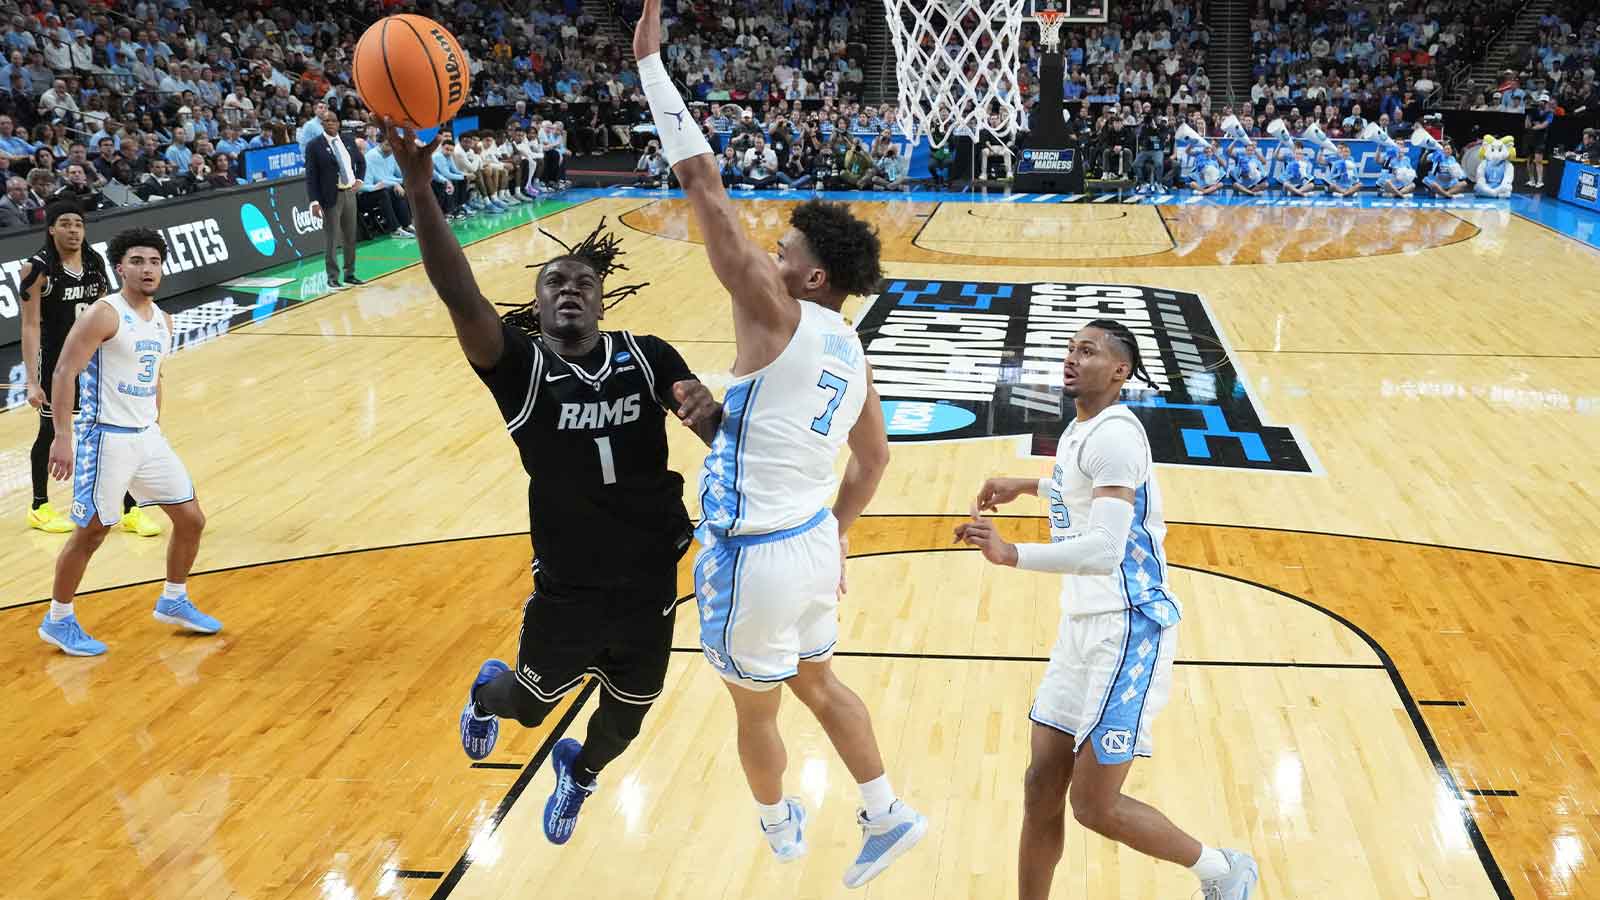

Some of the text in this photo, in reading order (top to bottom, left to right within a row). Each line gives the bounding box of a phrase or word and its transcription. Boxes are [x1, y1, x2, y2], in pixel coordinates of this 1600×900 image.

[431, 28, 462, 106] Wilson
[268, 154, 280, 170] THE
[280, 152, 296, 168] ROAD
[1031, 151, 1060, 161] MARCH
[1034, 160, 1072, 170] MADNESS
[292, 200, 324, 235] Coca-Co
[158, 218, 229, 276] LETES
[138, 354, 157, 384] 3
[866, 309, 1010, 401] MARCH
[557, 393, 640, 430] RAMS
[811, 369, 848, 436] 7
[594, 436, 616, 485] 1
[1048, 487, 1070, 529] 5
[523, 663, 542, 684] VCU
